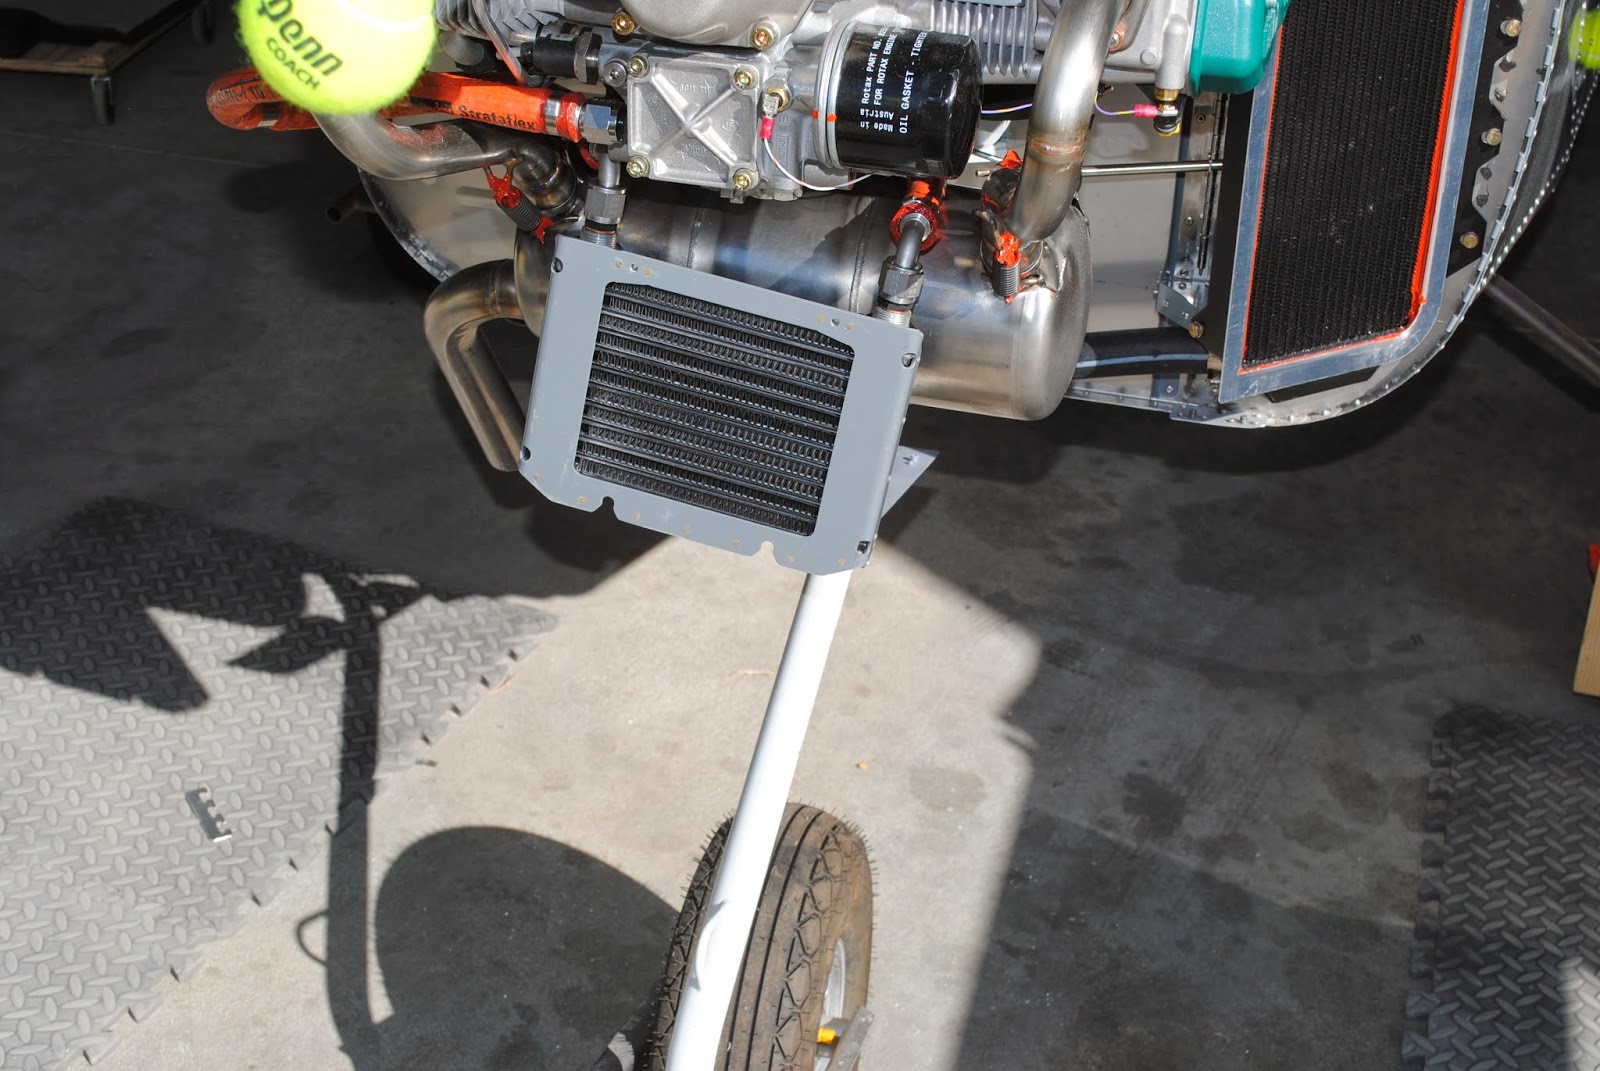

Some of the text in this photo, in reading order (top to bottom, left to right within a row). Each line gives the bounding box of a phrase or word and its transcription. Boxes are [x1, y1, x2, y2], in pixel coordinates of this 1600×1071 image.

[266, 38, 321, 90] COACH
[861, 38, 883, 105] Rotax PART NO.
[876, 57, 889, 84] ROTAX
[874, 88, 883, 106] FOR
[901, 70, 915, 110] GASKET
[860, 108, 895, 121] Austria
[899, 114, 909, 134] OIL
[873, 122, 894, 133] Made
